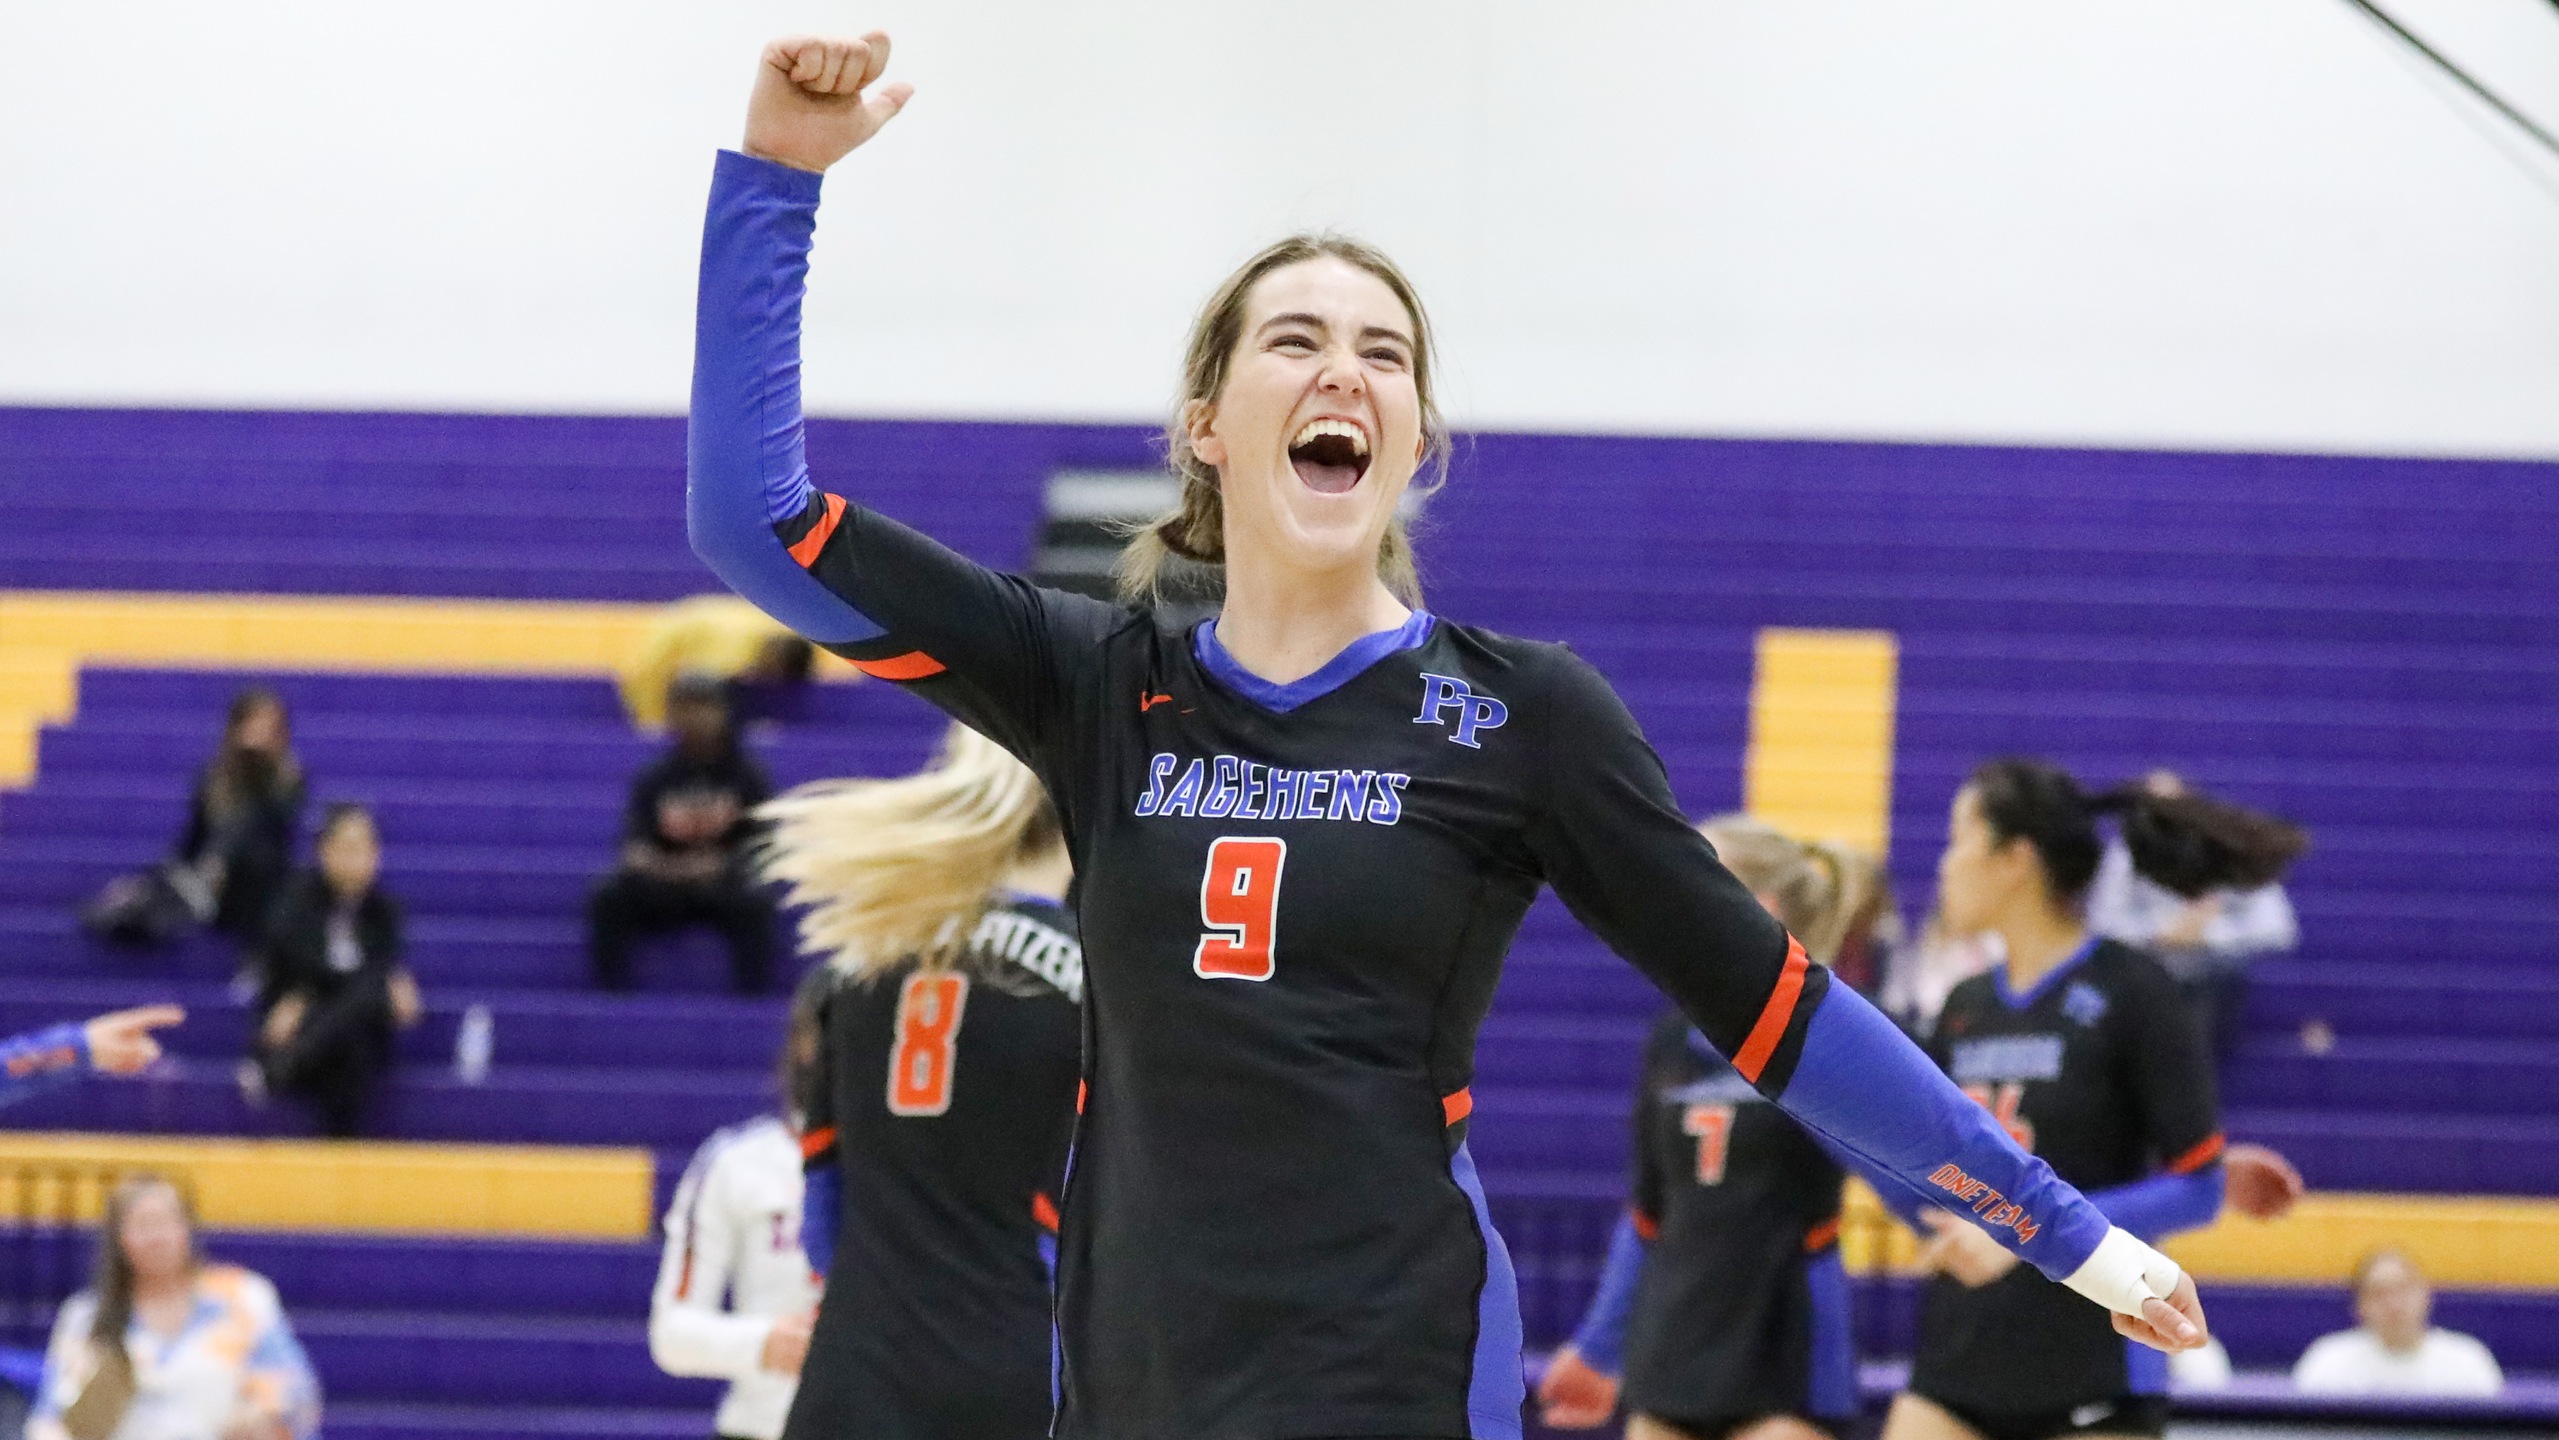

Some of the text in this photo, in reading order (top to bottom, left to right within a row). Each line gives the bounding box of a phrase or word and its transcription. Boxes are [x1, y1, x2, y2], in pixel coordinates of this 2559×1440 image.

[1413, 672, 1508, 749] PP
[1134, 752, 1411, 826] SAGEHENS
[1193, 836, 1287, 982] 9
[886, 969, 970, 1117] 8
[1681, 1104, 1737, 1186] 7
